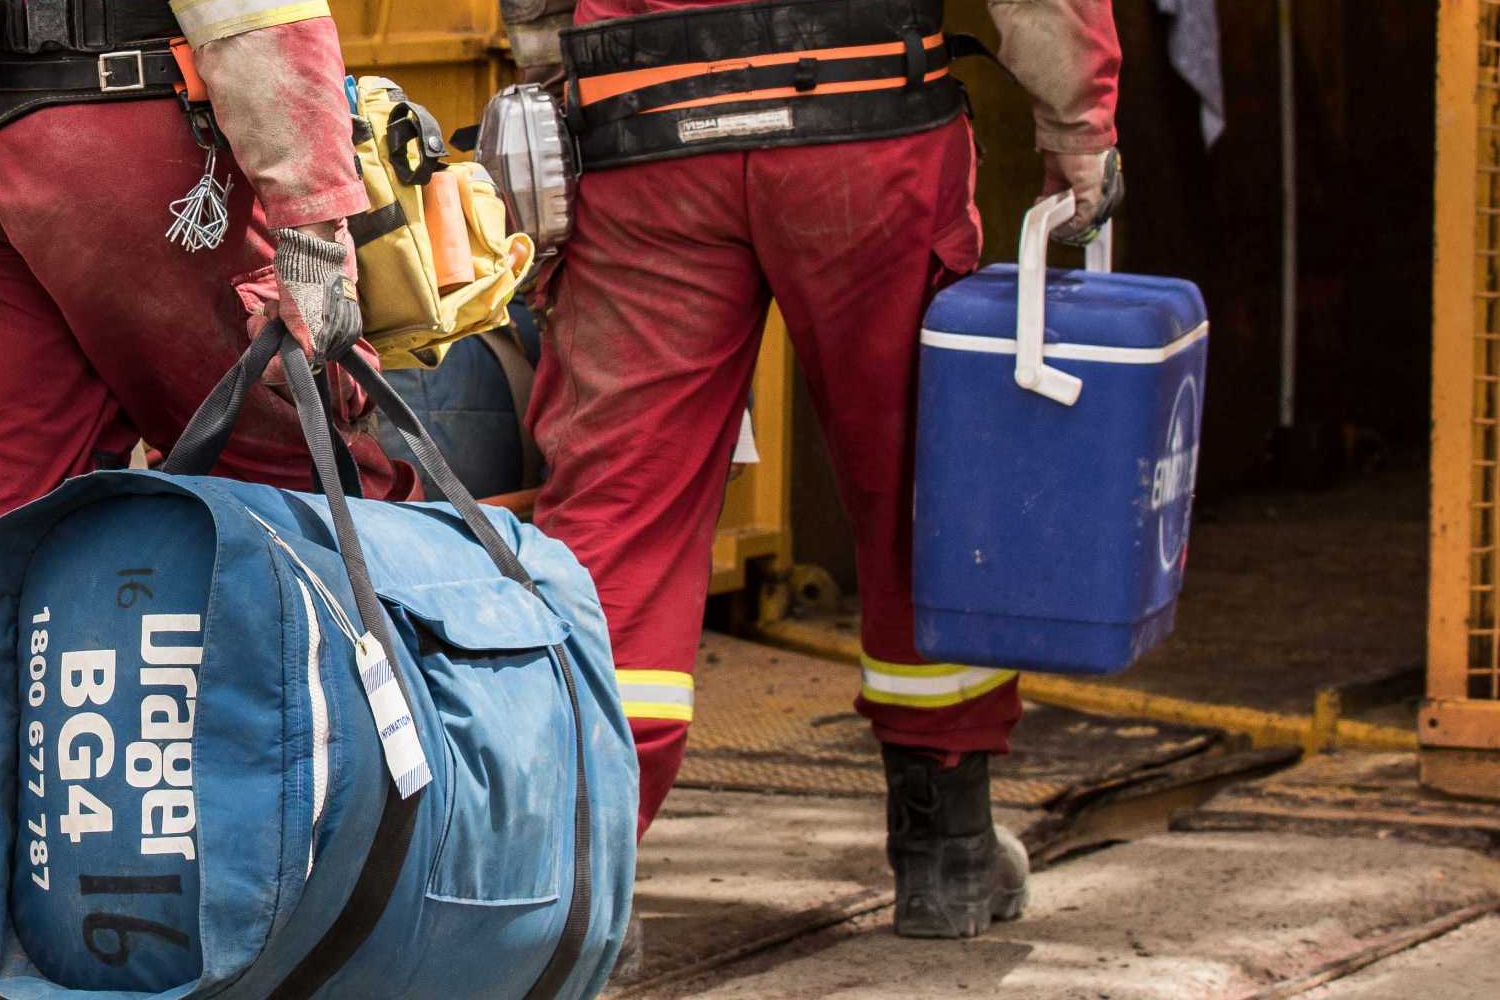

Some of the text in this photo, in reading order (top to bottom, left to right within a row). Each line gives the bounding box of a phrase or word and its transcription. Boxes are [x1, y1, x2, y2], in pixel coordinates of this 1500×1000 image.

[28, 606, 51, 892] 1800 677 787
[57, 649, 117, 844] BG4
